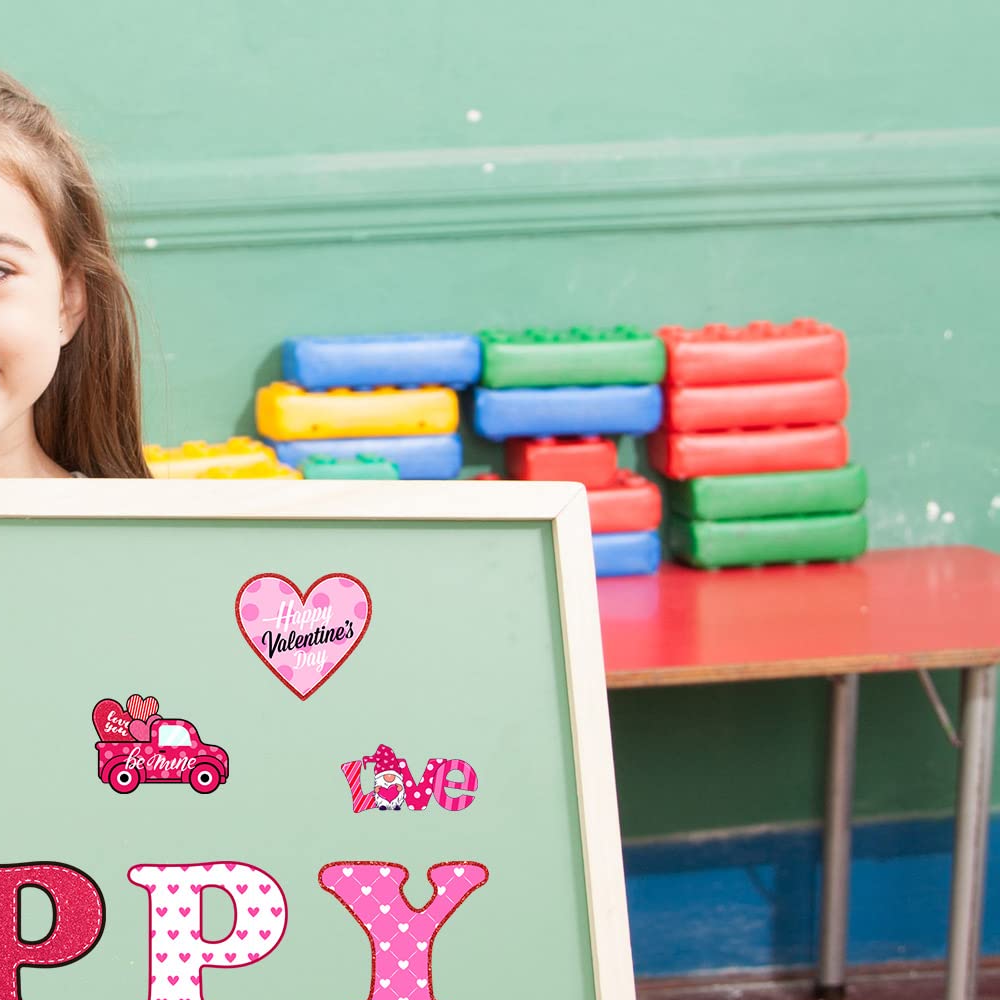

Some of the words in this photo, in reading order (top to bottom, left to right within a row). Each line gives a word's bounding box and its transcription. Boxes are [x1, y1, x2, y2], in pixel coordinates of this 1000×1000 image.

[262, 599, 333, 632] Happy
[261, 619, 354, 659] Valentine's
[293, 650, 328, 673] Day
